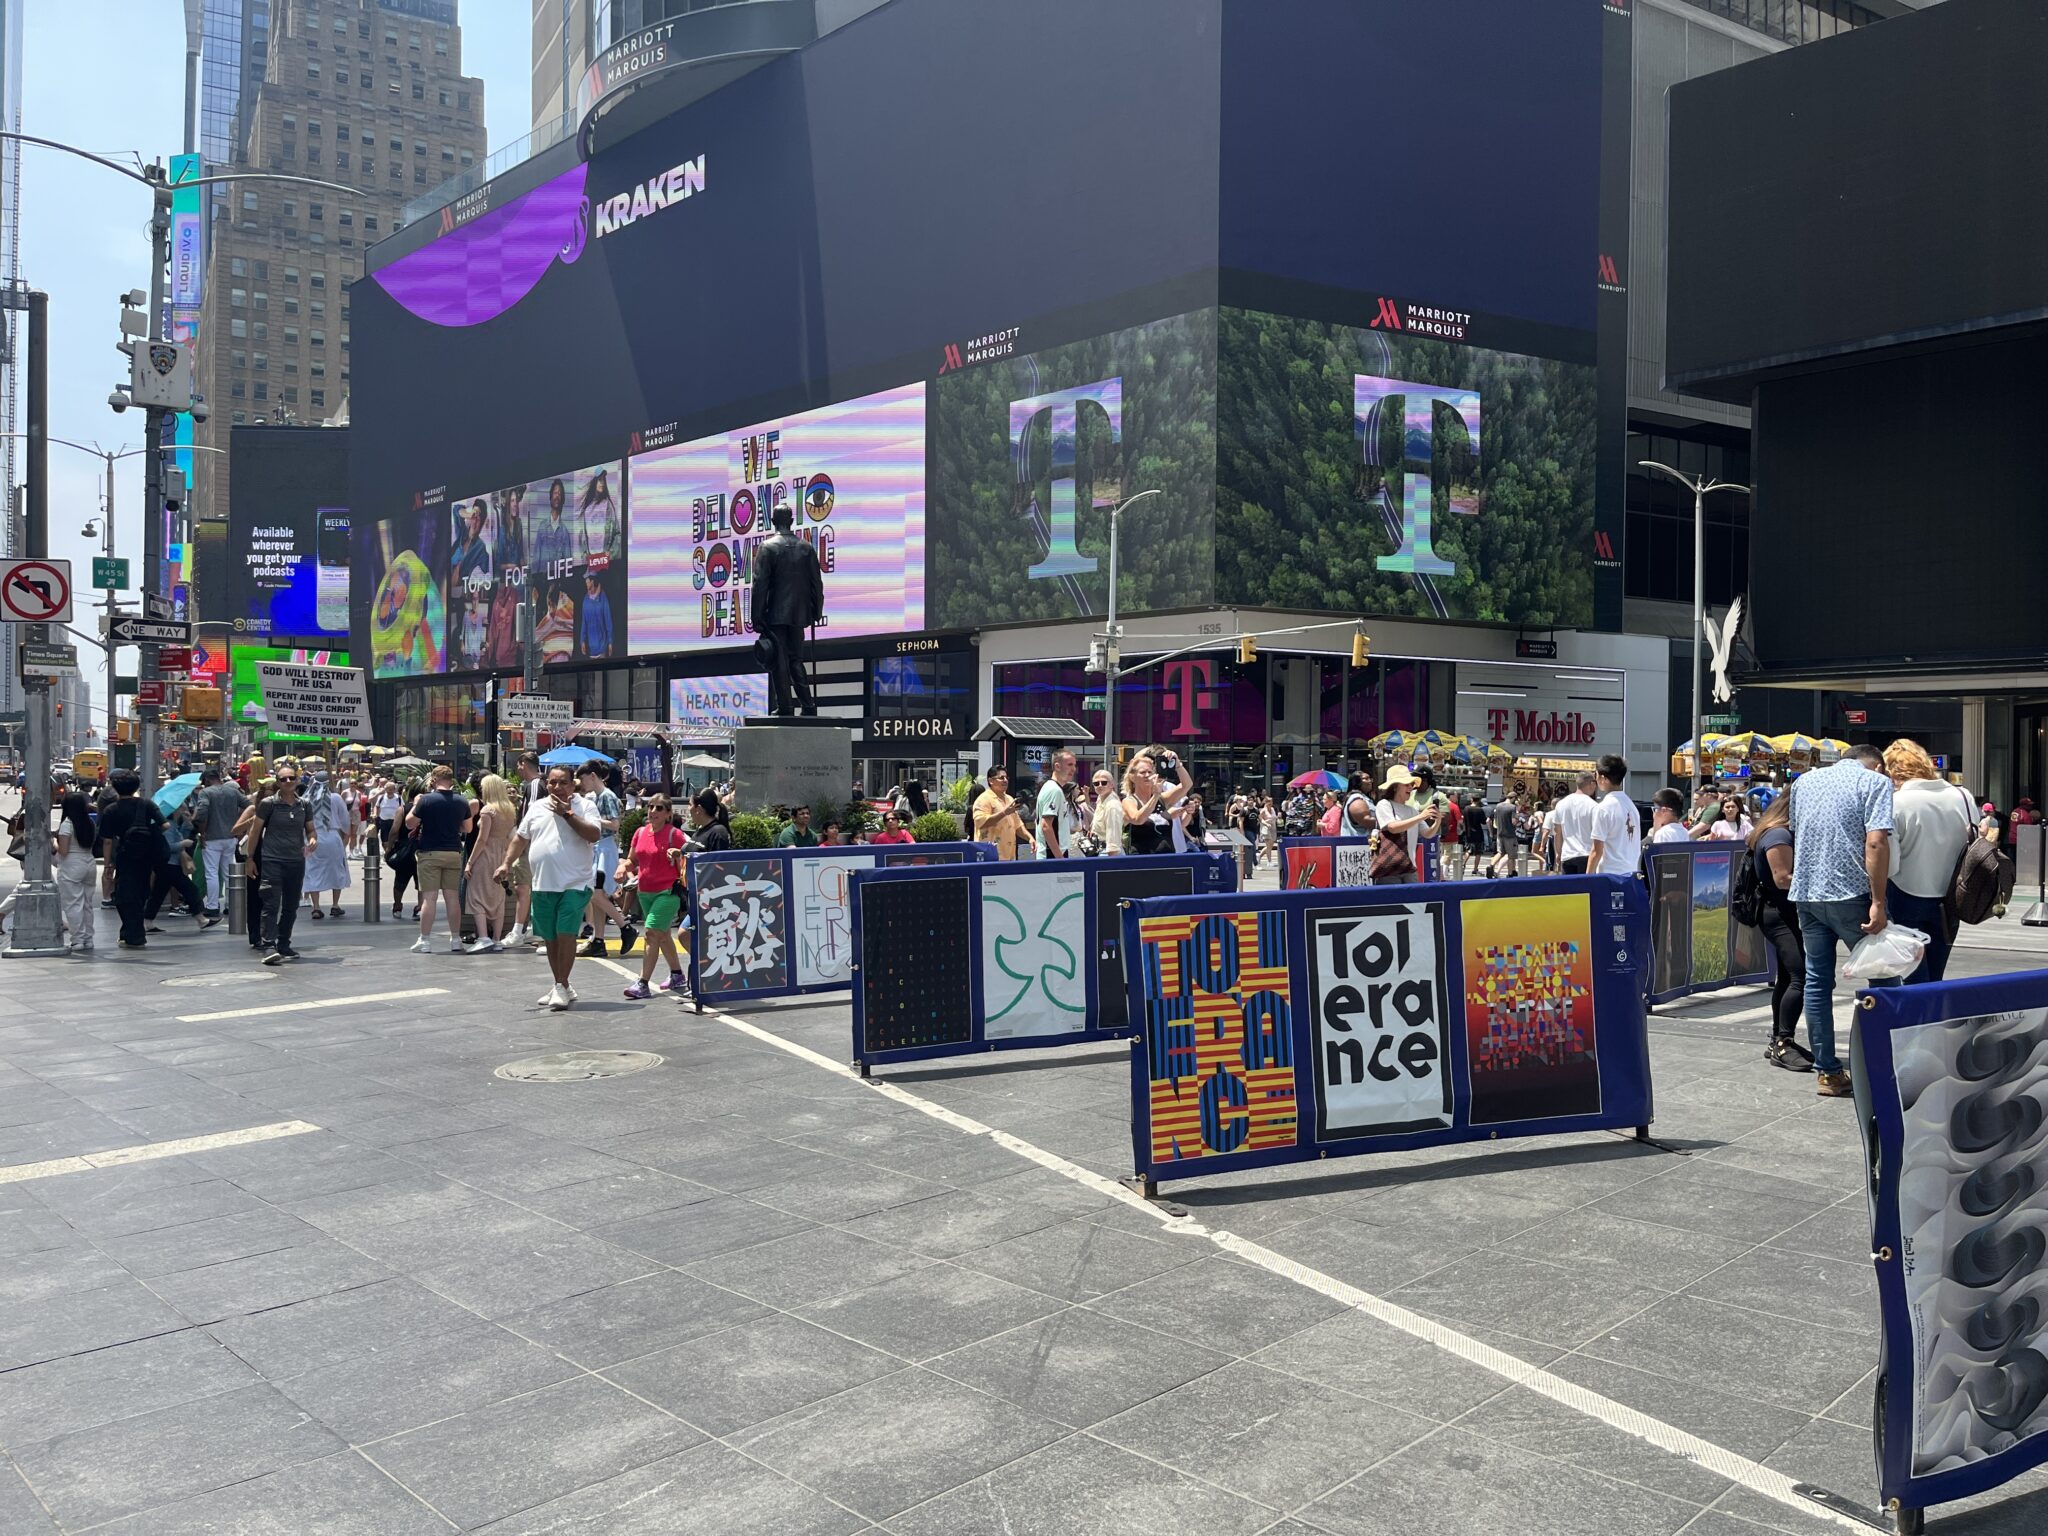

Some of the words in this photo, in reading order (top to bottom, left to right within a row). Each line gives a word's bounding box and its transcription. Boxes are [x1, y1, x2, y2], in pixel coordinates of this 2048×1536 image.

[608, 24, 675, 66] MARRIOTT
[607, 47, 664, 85] MARQUIS
[456, 184, 492, 209] MARRIOTT
[596, 154, 706, 238] KRAKEN
[456, 201, 488, 224] MARQUIS
[179, 253, 190, 292] LIQUID
[1598, 284, 1626, 294] MARRIOTT
[1408, 304, 1470, 325] MARRIOTT
[1408, 319, 1464, 338] MARQUIS
[967, 327, 1020, 350] MARRIOTT
[967, 341, 1014, 364] MARQUIS
[645, 422, 678, 437] MARRIOTT
[645, 433, 674, 448] MARQUIS
[742, 430, 779, 483] WE
[252, 527, 294, 538] Available
[252, 540, 295, 551] wherever
[246, 554, 263, 565] you
[265, 553, 280, 565] get
[281, 554, 302, 564] your
[253, 566, 296, 578] podcasts
[547, 558, 573, 580] LIFE
[462, 576, 491, 594] TOPS
[122, 625, 145, 635] ONE
[157, 628, 180, 637] WAY
[247, 624, 271, 632] CENTRAL
[1197, 623, 1221, 634] 1535
[896, 639, 939, 652] SEPHORA
[263, 666, 282, 676] GOD
[285, 668, 308, 679] WILL
[311, 670, 356, 681] DESTROY
[291, 678, 309, 688] THE
[312, 680, 332, 690] USA
[266, 691, 298, 700] REPENT
[300, 694, 317, 702] AND
[320, 695, 342, 704] OBEY
[344, 697, 362, 705] OUR
[686, 693, 728, 710] HEART
[732, 692, 751, 708] OF
[1163, 660, 1218, 735] T
[273, 701, 294, 710] LORD
[296, 703, 323, 712] JESUS
[325, 705, 356, 714] CHRIST
[277, 714, 289, 722] HE
[291, 715, 318, 725] LOVES
[320, 718, 338, 726] YOU
[340, 719, 359, 727] AND
[873, 718, 953, 737] SEPHORA
[1514, 709, 1596, 744] Mobile
[1711, 717, 1739, 725] Broadway
[286, 724, 307, 733] TIME
[310, 726, 318, 734] IS
[321, 727, 350, 736] SHORT
[1318, 919, 1410, 979] Tol
[1324, 980, 1434, 1032] era
[1326, 1032, 1438, 1086] nce
